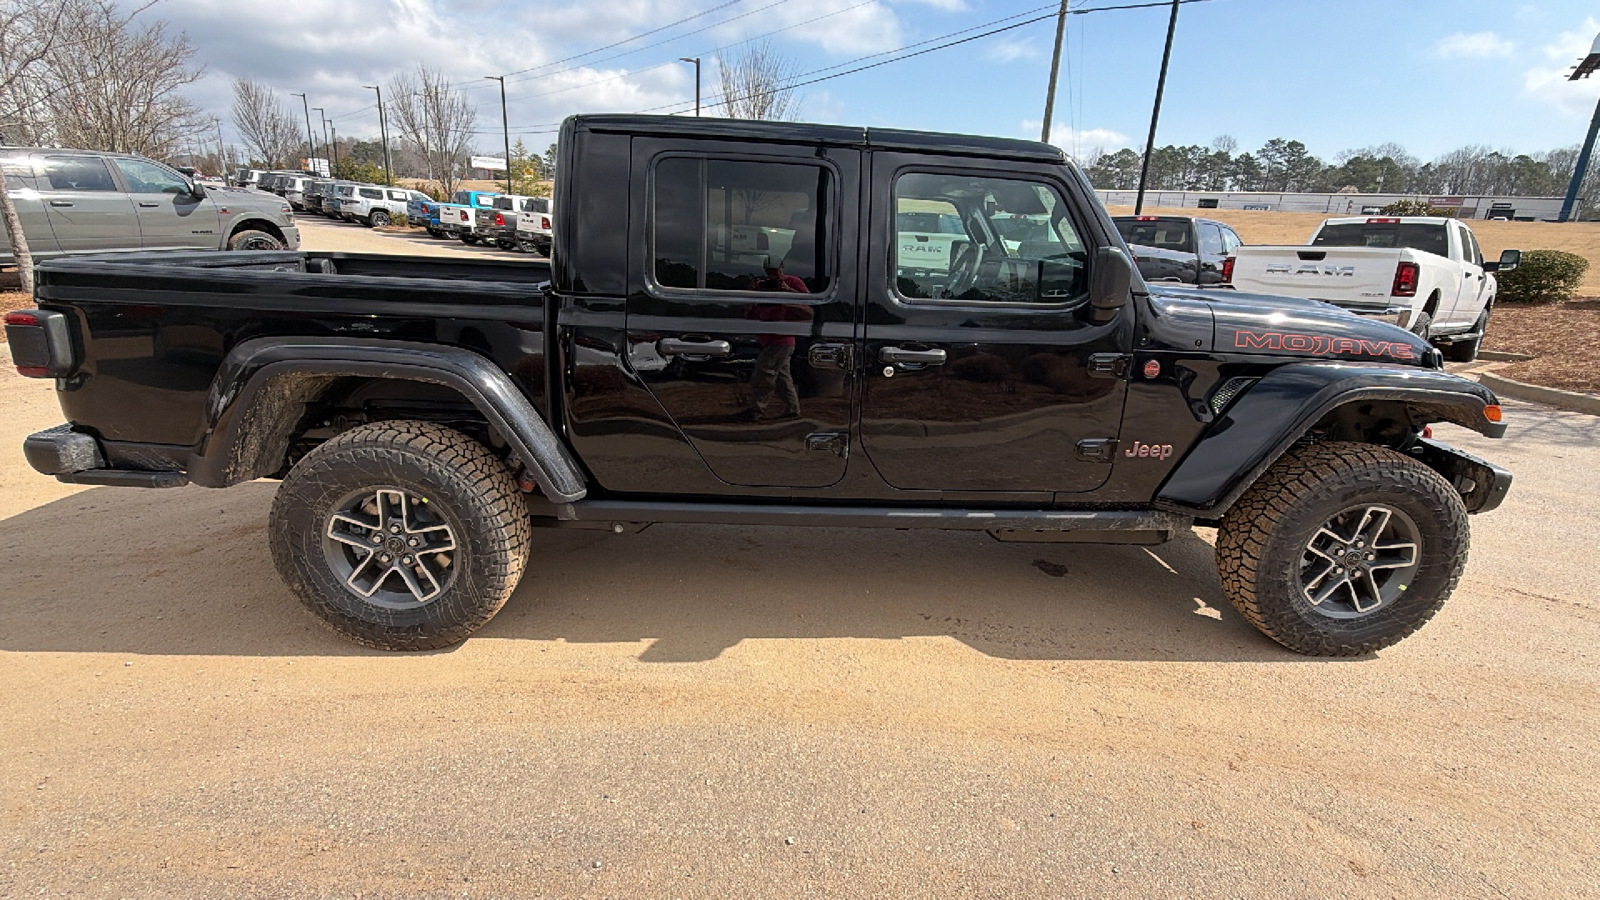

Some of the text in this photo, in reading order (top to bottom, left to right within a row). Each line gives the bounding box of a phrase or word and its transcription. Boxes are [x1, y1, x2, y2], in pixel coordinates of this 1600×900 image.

[902, 244, 942, 253] RAM
[1265, 263, 1355, 277] RAM
[1235, 330, 1414, 359] MOJAVE
[1125, 441, 1174, 461] Jeep
